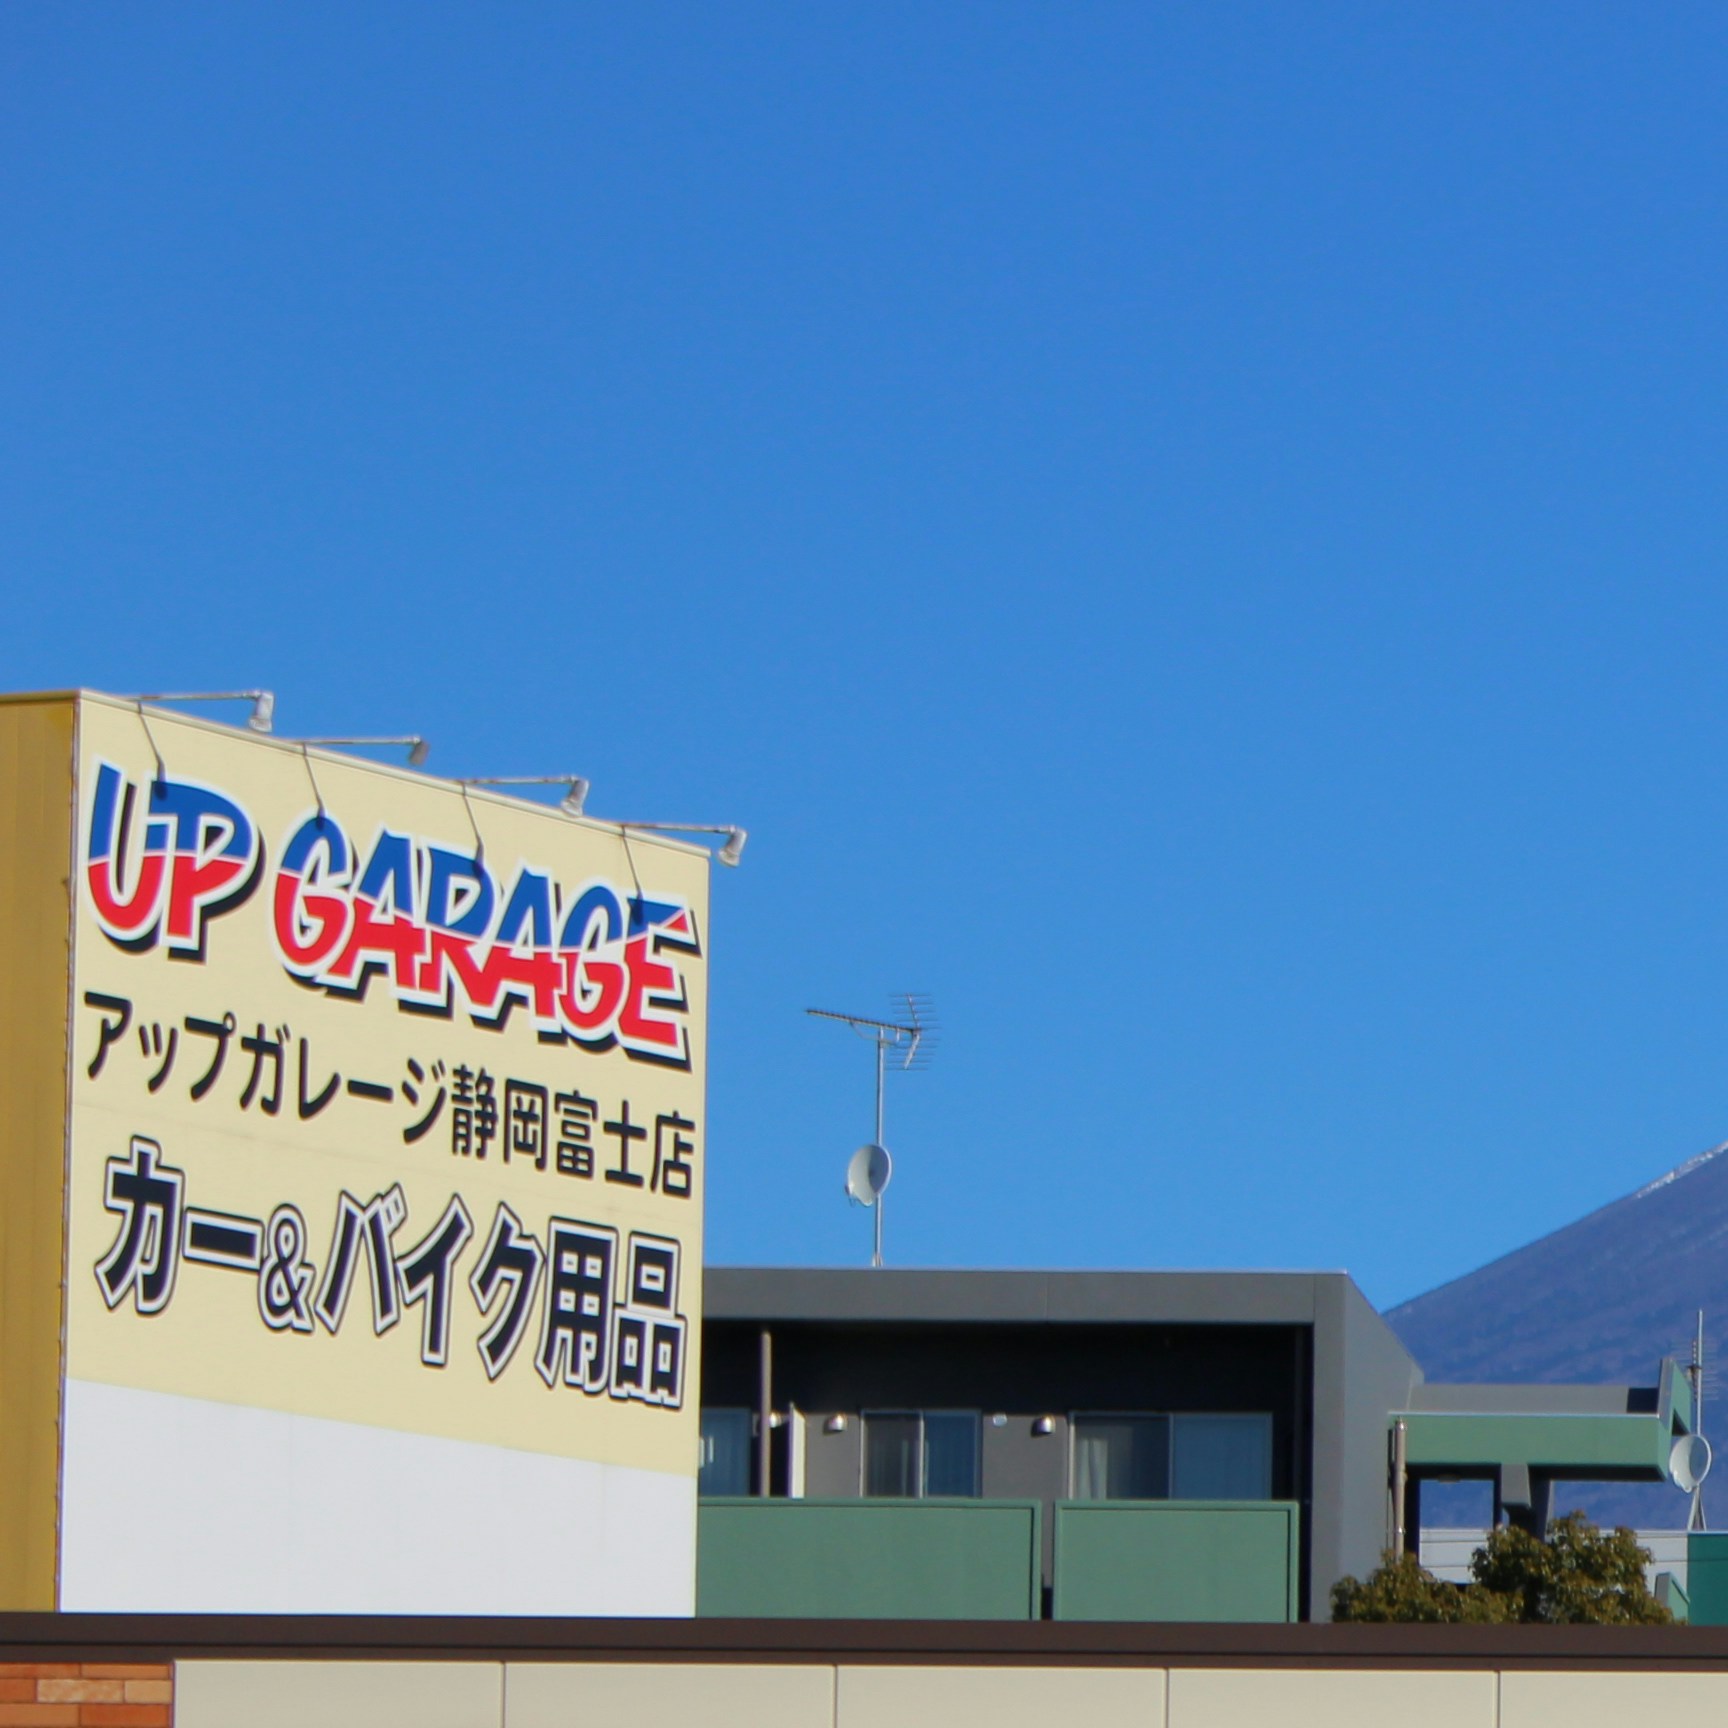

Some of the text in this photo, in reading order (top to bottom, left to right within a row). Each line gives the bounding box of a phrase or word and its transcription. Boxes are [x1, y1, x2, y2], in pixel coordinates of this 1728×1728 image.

[86, 762, 699, 1072] UP GARAGE
[84, 990, 695, 1200] アップガレージ静岡富士店
[95, 1136, 688, 1407] カー&バイク用品
